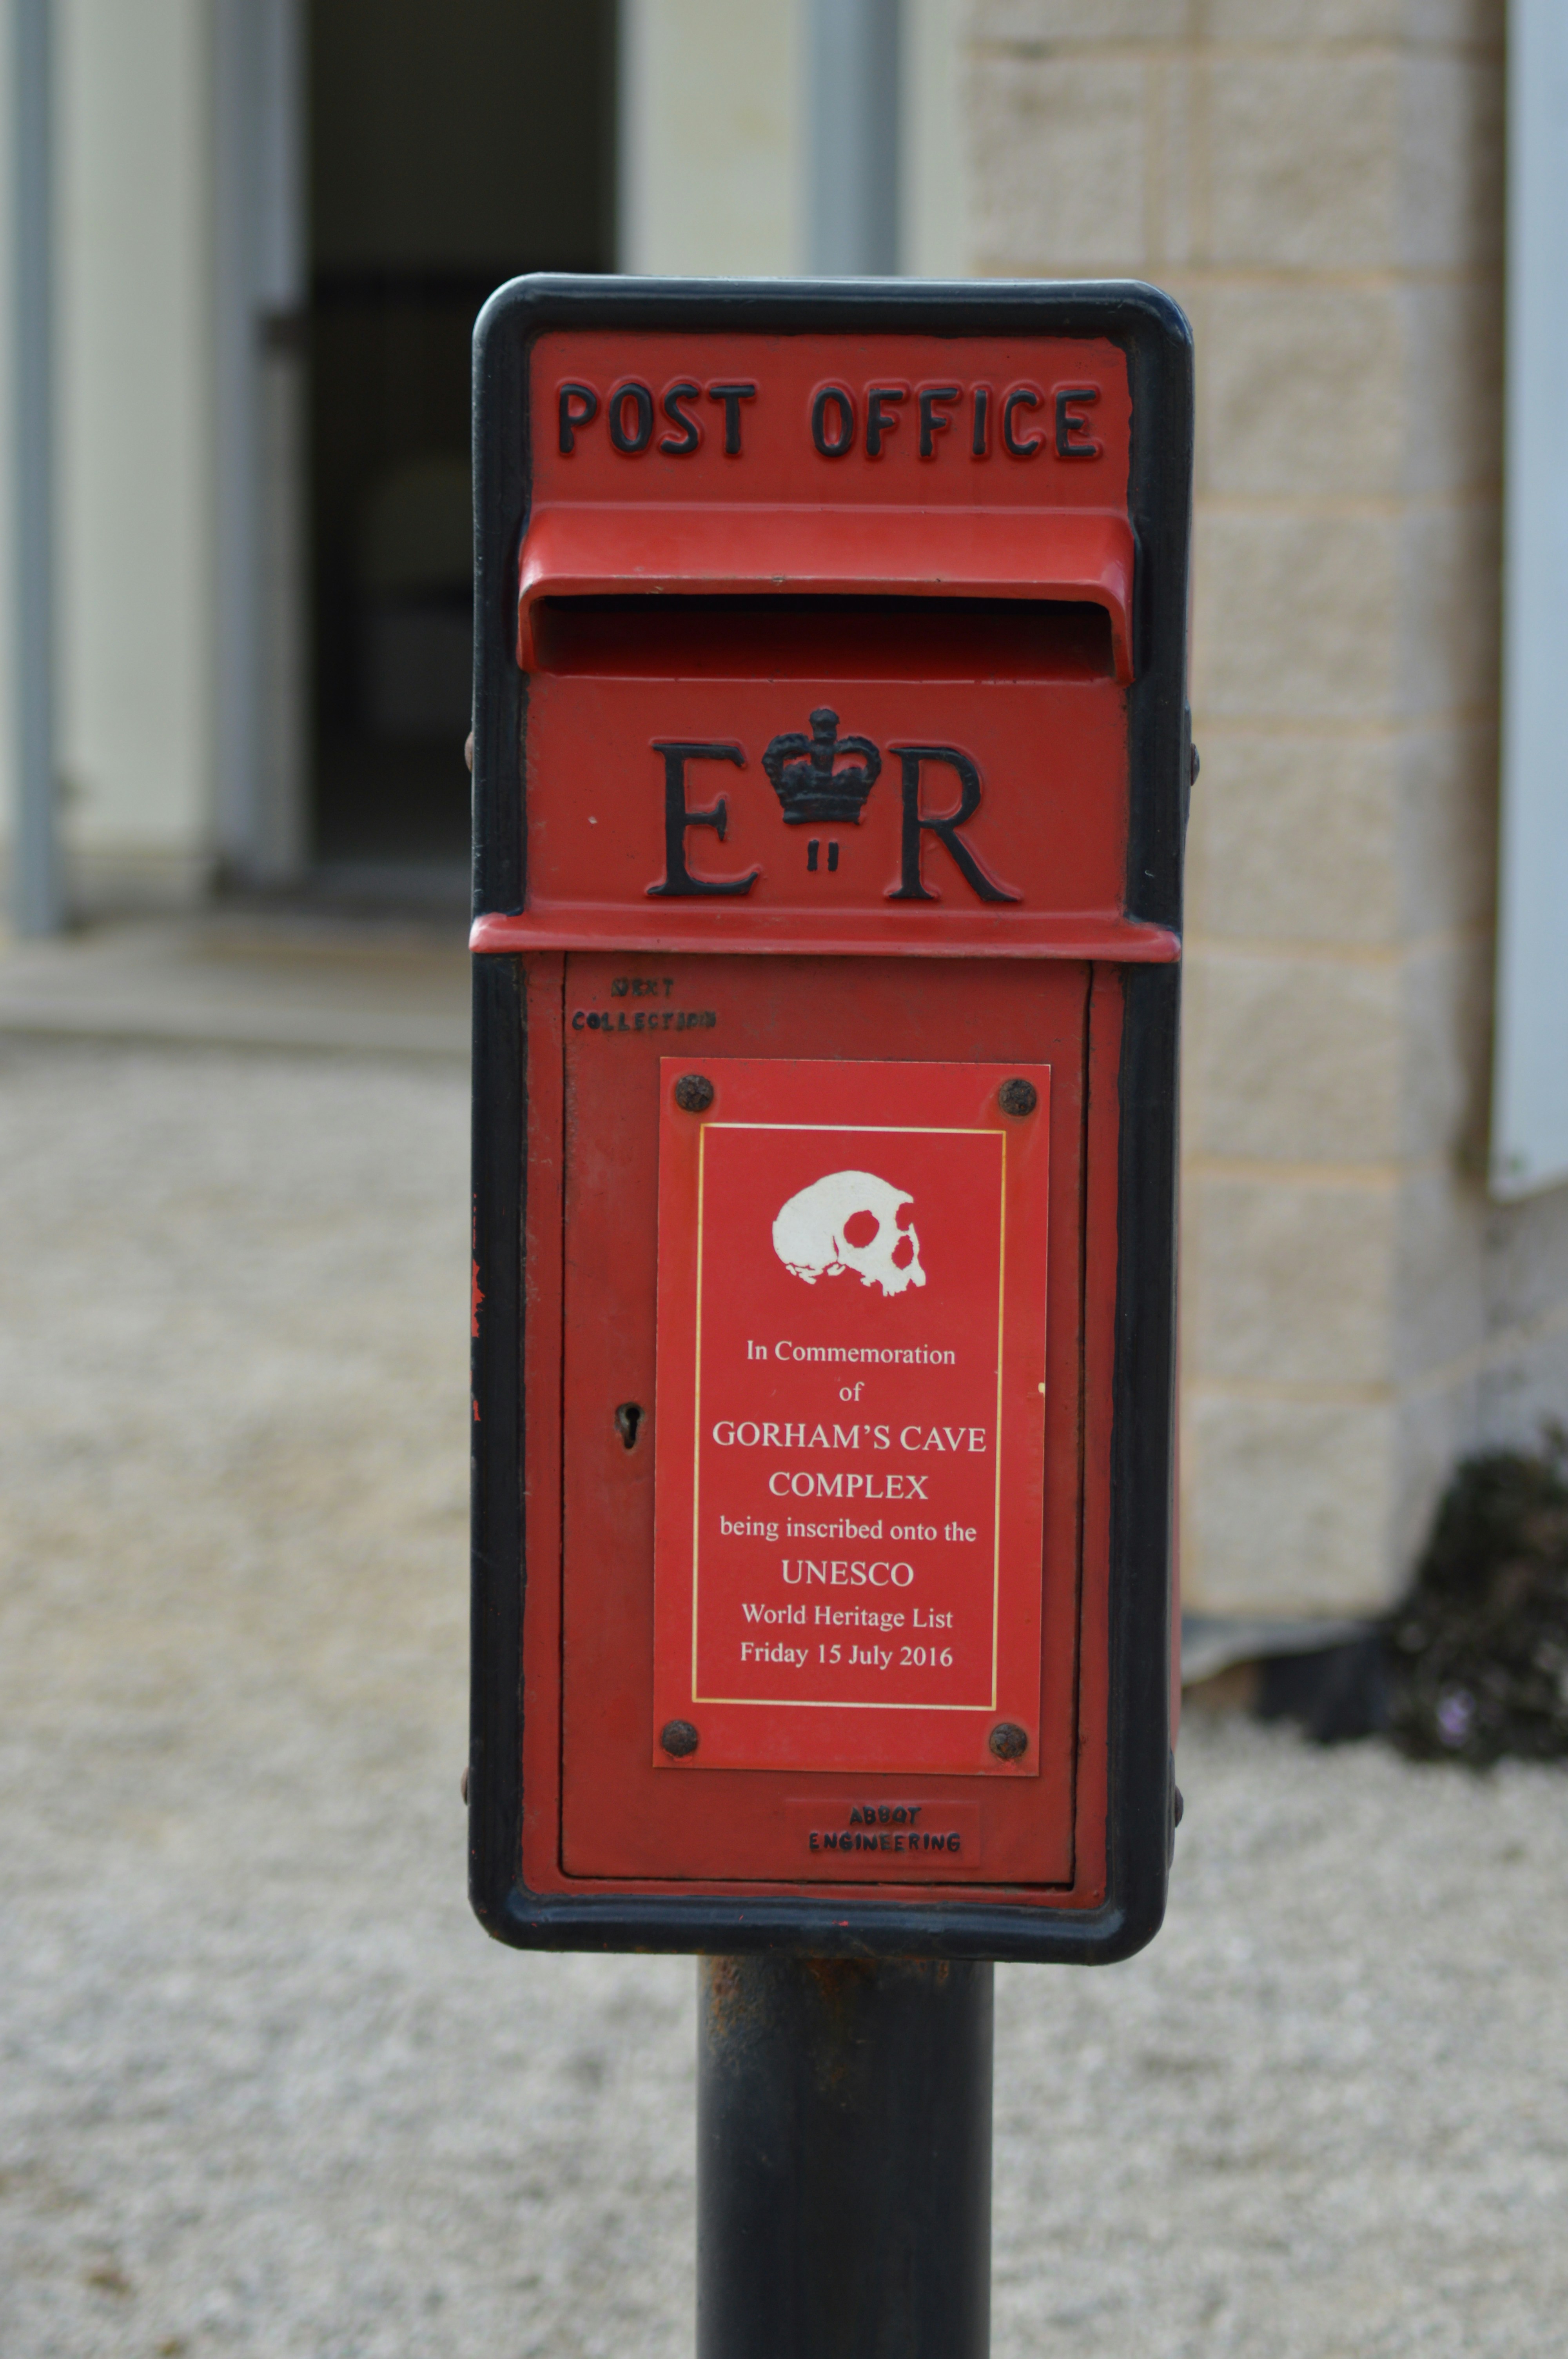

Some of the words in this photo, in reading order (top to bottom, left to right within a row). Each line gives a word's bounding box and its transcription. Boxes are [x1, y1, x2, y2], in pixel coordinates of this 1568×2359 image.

[559, 382, 755, 454] POST
[811, 386, 1097, 457] OFFICE
[646, 743, 759, 896] E
[887, 746, 1020, 902] R
[611, 978, 674, 997] NEXT
[572, 1011, 716, 1031] COLLECTION
[747, 1339, 768, 1360] In
[774, 1340, 955, 1365] Commemoration
[839, 1381, 865, 1402] of
[712, 1420, 891, 1450] GORHAM’S
[900, 1425, 987, 1452] CAVE
[768, 1471, 929, 1500] COMPLEX
[720, 1515, 779, 1542] being
[786, 1518, 883, 1539] inscribed
[889, 1523, 938, 1541] onto
[944, 1521, 977, 1542] the
[782, 1559, 914, 1587] UNESCO
[741, 1603, 806, 1625] World
[814, 1605, 905, 1632] Heritage
[913, 1608, 953, 1628] List
[740, 1641, 809, 1668] Friday
[819, 1643, 841, 1664] 15
[848, 1645, 893, 1670] July
[900, 1645, 953, 1667] 2016
[849, 1805, 922, 1825] ABBOT
[809, 1832, 961, 1852] ENGINEERING
